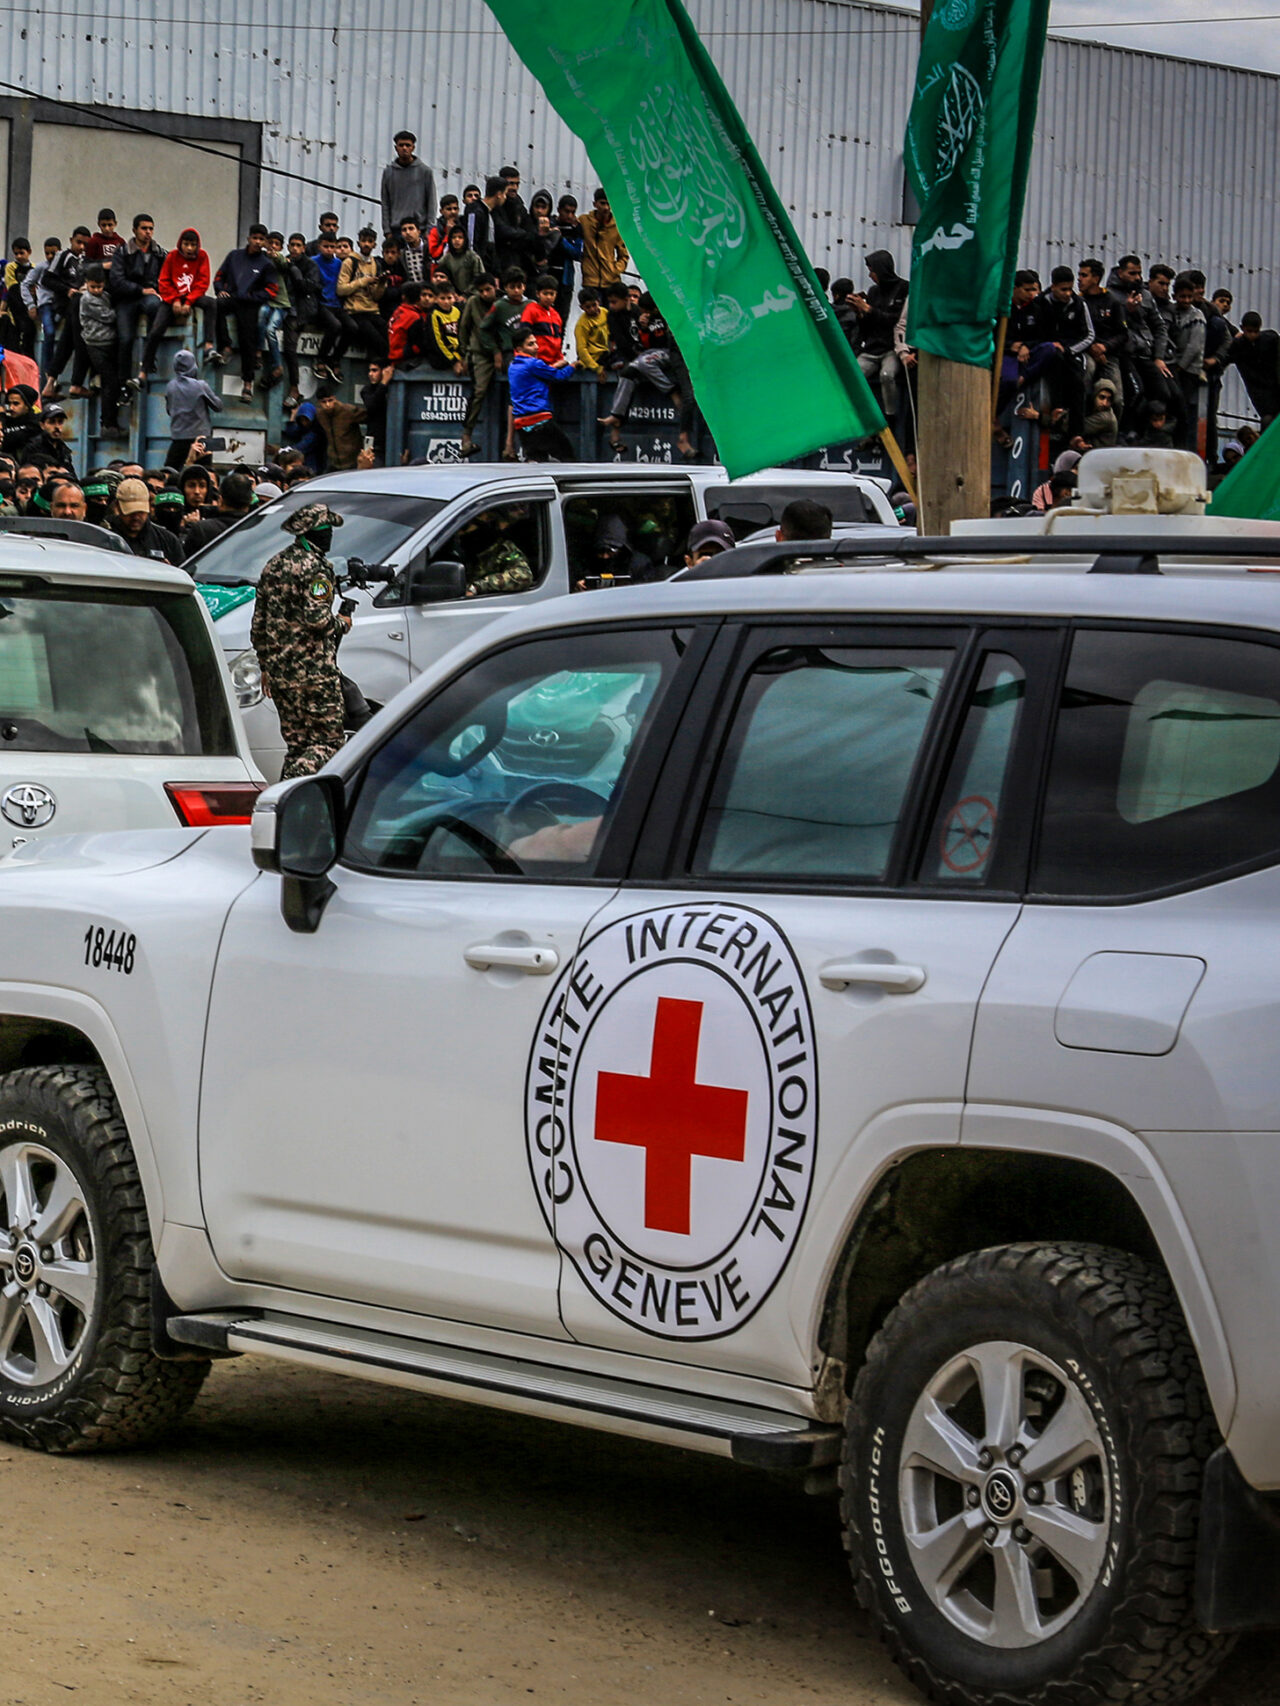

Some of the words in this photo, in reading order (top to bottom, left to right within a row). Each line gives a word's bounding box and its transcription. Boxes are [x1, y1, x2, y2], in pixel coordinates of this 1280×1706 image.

[432, 383, 462, 396] חרש
[84, 924, 137, 975] 18448
[535, 958, 604, 1204] COMITE
[625, 911, 808, 1243] INTERNATIONAL
[583, 1232, 750, 1326] GENEVE
[865, 1427, 912, 1614] BFGoodrich
